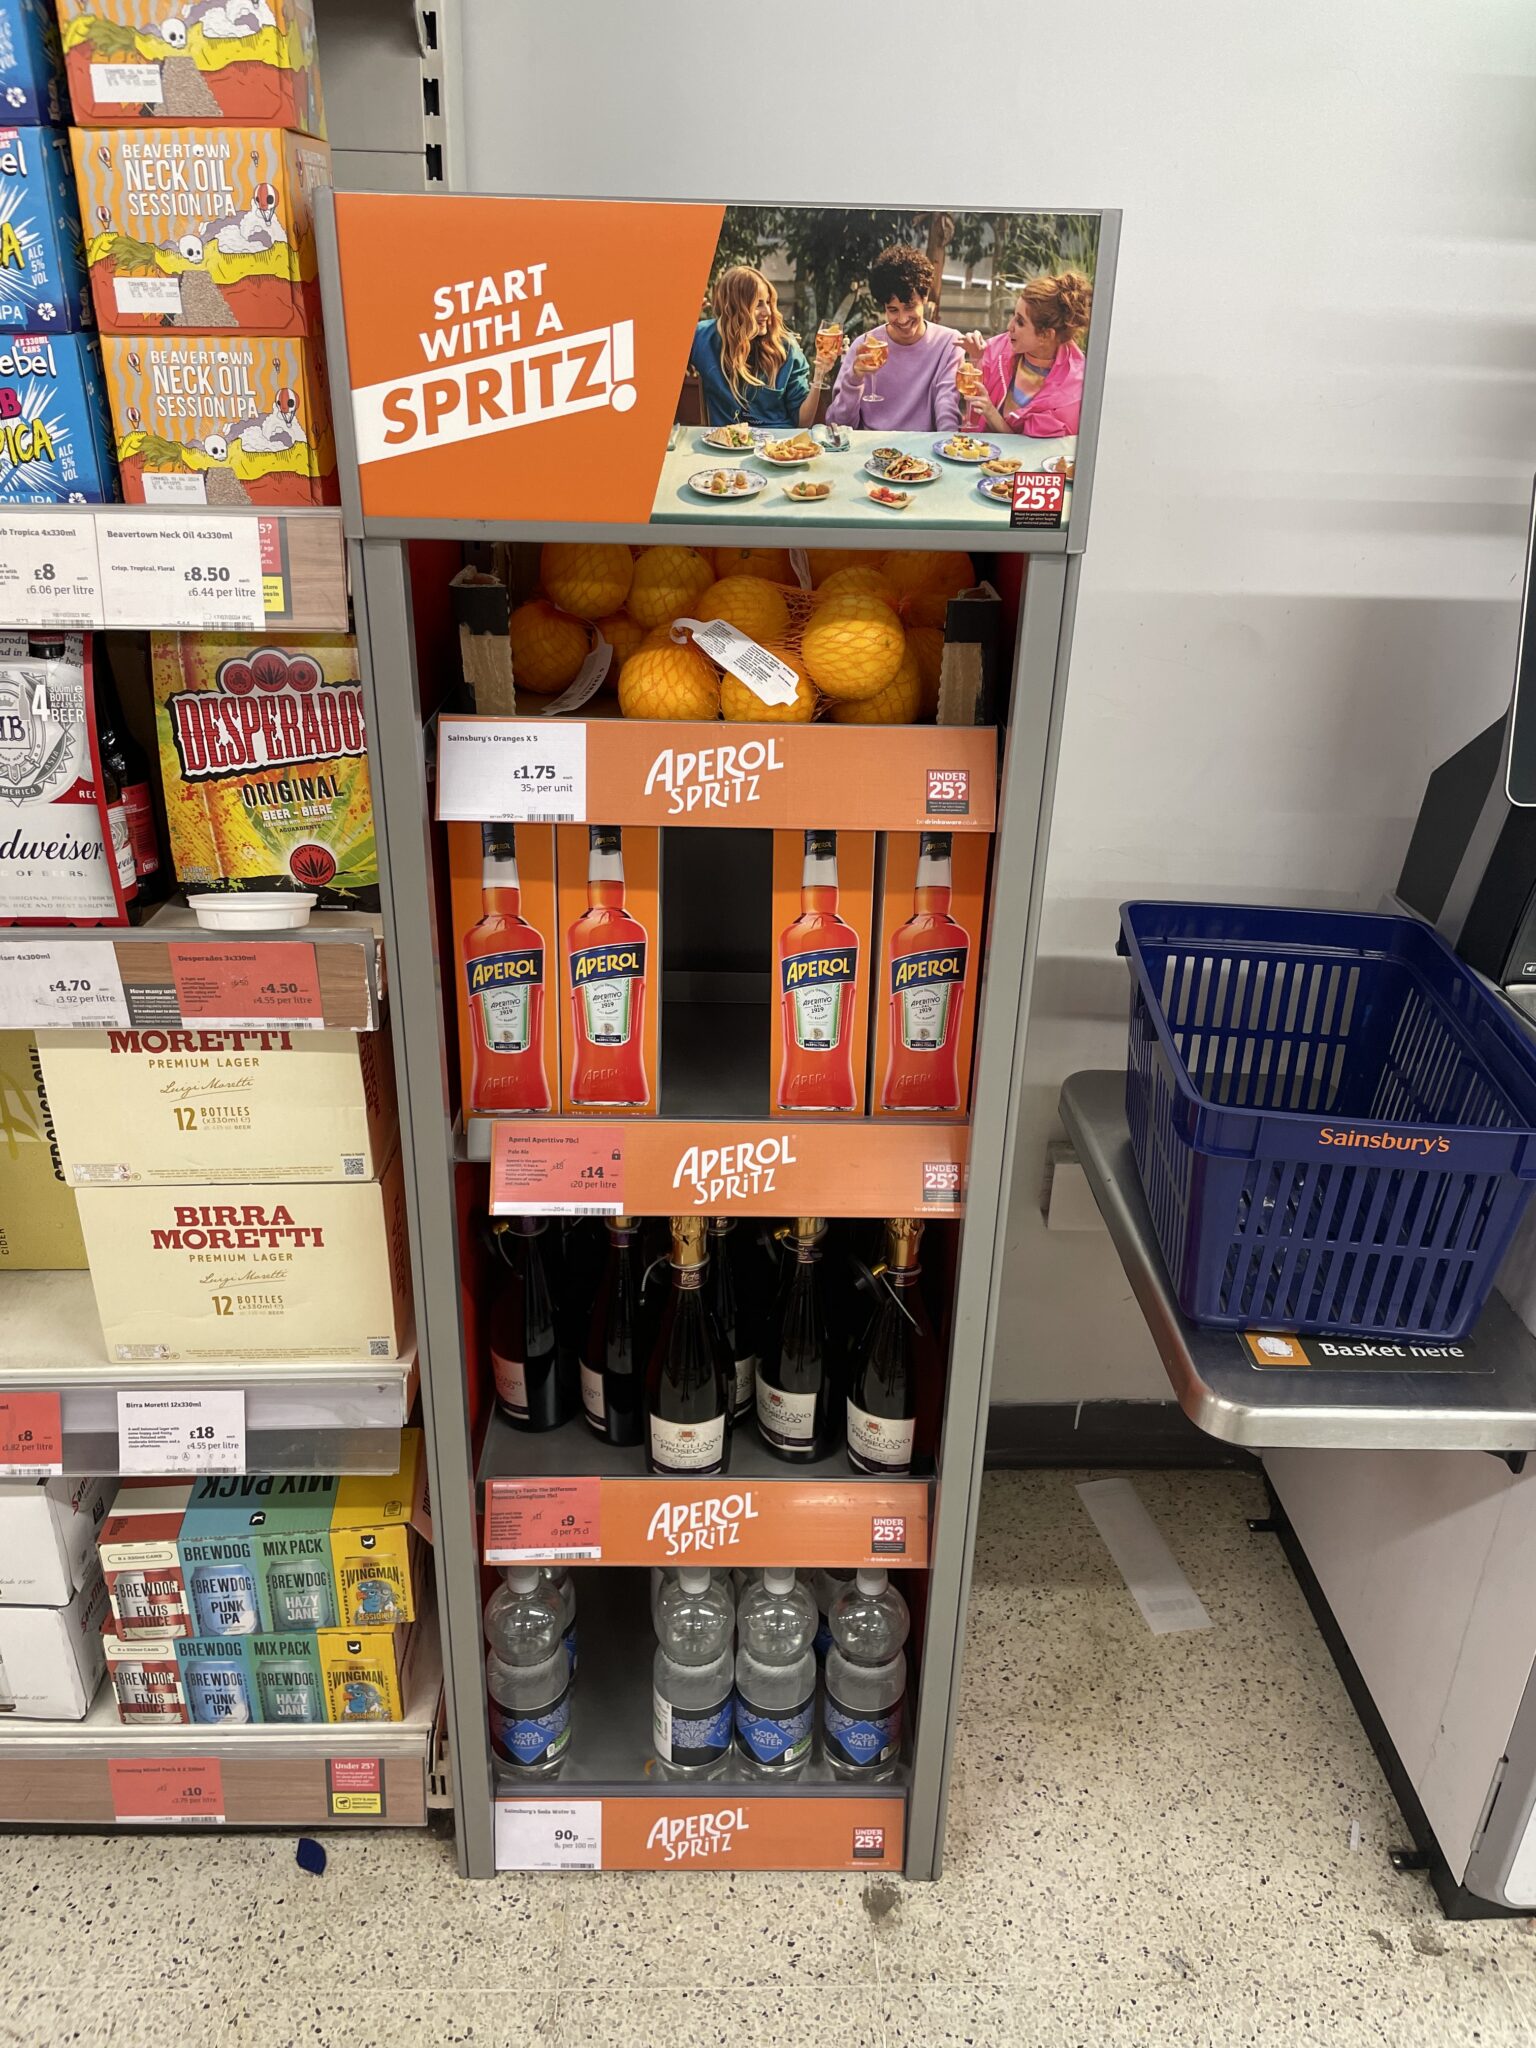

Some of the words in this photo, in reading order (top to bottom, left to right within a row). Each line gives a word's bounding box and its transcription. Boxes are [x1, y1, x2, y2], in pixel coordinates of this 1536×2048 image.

[122, 144, 231, 158] BEAVERTOWN
[124, 159, 189, 192] NECK
[194, 159, 234, 192] OIL
[129, 192, 203, 216] SESSION
[207, 193, 236, 216] IPA
[28, 245, 43, 260] ALC
[31, 272, 48, 286] VOL
[433, 262, 547, 321] START
[418, 310, 521, 363] WITH
[535, 302, 564, 337] A
[150, 351, 254, 364] BEAVERTOWN
[153, 365, 215, 395] NECK
[218, 366, 257, 396] OIL
[381, 319, 637, 445] SPRITZ!
[157, 396, 225, 417] SESSION
[231, 397, 259, 418] IPA
[59, 443, 74, 458] ALC
[62, 457, 75, 470] 5%
[62, 469, 78, 482] VOL
[1017, 475, 1061, 486] UNDER
[1014, 487, 1060, 509] 25?
[107, 531, 157, 539] Beavertown
[159, 531, 181, 539] Neck
[183, 531, 194, 539] Oil
[34, 563, 56, 581] £8
[184, 567, 230, 582] £8.50
[54, 586, 70, 597] per
[74, 585, 94, 595] litre
[189, 588, 214, 597] £6.44
[216, 589, 233, 598] per
[235, 588, 256, 597] litre
[32, 684, 50, 721] 4
[50, 692, 83, 702] BOTTLES
[51, 709, 85, 722] BEER
[448, 735, 492, 743] Sainsbury's
[513, 765, 556, 779] £1.75
[644, 738, 784, 796] APEROL
[929, 772, 966, 781] UNDER
[242, 775, 344, 808] ORIGINAL
[521, 783, 535, 793] 35p
[537, 784, 552, 794] per
[554, 783, 573, 792] unit
[929, 781, 966, 799] 25?
[262, 808, 290, 820] BEER
[301, 803, 333, 817] BIÈRE
[0, 829, 104, 861] dweiser
[472, 959, 537, 988] APEROL
[575, 953, 639, 981] APEROL
[787, 958, 850, 985] APEROL
[896, 957, 960, 986] APEROL
[50, 980, 91, 992] £4.70
[261, 983, 297, 993] £4.50
[80, 996, 94, 1004] per
[97, 995, 115, 1003] litre
[592, 991, 622, 1001] APERITIVO
[803, 997, 832, 1006] APERITIVO
[911, 997, 940, 1007] APERITIVO
[490, 998, 520, 1009] APERITIVO
[107, 1030, 293, 1053] MORETTI
[149, 1058, 209, 1069] PREMIUM
[217, 1058, 260, 1067] LAGER
[173, 1107, 197, 1131] 12
[201, 1106, 250, 1117] BOTTLES
[1318, 1128, 1450, 1155] Sainsbury's
[672, 1136, 796, 1188] APEROL
[925, 1164, 958, 1172] UNDER
[581, 1167, 604, 1178] £14
[585, 1182, 597, 1190] per
[925, 1173, 958, 1188] 25?
[174, 1205, 295, 1227] BIRRA
[150, 1228, 325, 1250] MORETTI
[189, 1254, 246, 1262] PREMIUM
[253, 1253, 293, 1261] LAGER
[212, 1296, 234, 1316] 12
[237, 1295, 283, 1304] BOTTLES
[1318, 1343, 1406, 1357] Basket
[18, 1430, 33, 1442] £8
[190, 1426, 215, 1439] £18
[660, 1444, 713, 1454] PROSECCO
[561, 1515, 575, 1526] £9
[647, 1492, 758, 1540] APEROL
[873, 1519, 904, 1527] UNDER
[873, 1527, 904, 1541] 25?
[184, 1543, 251, 1562] BREWDOG
[263, 1541, 286, 1556] MIX
[291, 1539, 323, 1554] PACK
[272, 1572, 326, 1589] BREWDOG
[346, 1566, 399, 1588] WINGMAN
[120, 1581, 175, 1598] BREWDOG
[196, 1576, 252, 1594] BREWDOG
[211, 1601, 245, 1613] PUNK
[285, 1595, 319, 1608] HAZY
[136, 1605, 168, 1617] ELVIS
[287, 1607, 319, 1620] JANE
[138, 1615, 171, 1627] JUICE
[220, 1613, 240, 1624] IPA
[179, 1642, 242, 1656] BREWDOG
[254, 1642, 276, 1656] MIX
[280, 1641, 311, 1655] PACK
[119, 1672, 172, 1686] BREWDOG
[190, 1673, 243, 1687] BREWDOG
[263, 1672, 314, 1686] BREWDOG
[332, 1671, 385, 1689] WINGMAN
[135, 1693, 164, 1703] ELVIS
[205, 1694, 237, 1705] PUNK
[276, 1693, 309, 1704] HAZY
[213, 1705, 232, 1715] IPA
[278, 1705, 309, 1716] JANE
[751, 1733, 783, 1746] WATER
[754, 1728, 779, 1739] SODA
[851, 1732, 876, 1740] SODA
[512, 1738, 544, 1746] WATER
[848, 1738, 880, 1747] WATER
[182, 1787, 202, 1796] £10
[555, 1830, 578, 1841] 90p
[647, 1808, 749, 1849] APEROL
[855, 1836, 883, 1848] 25?
